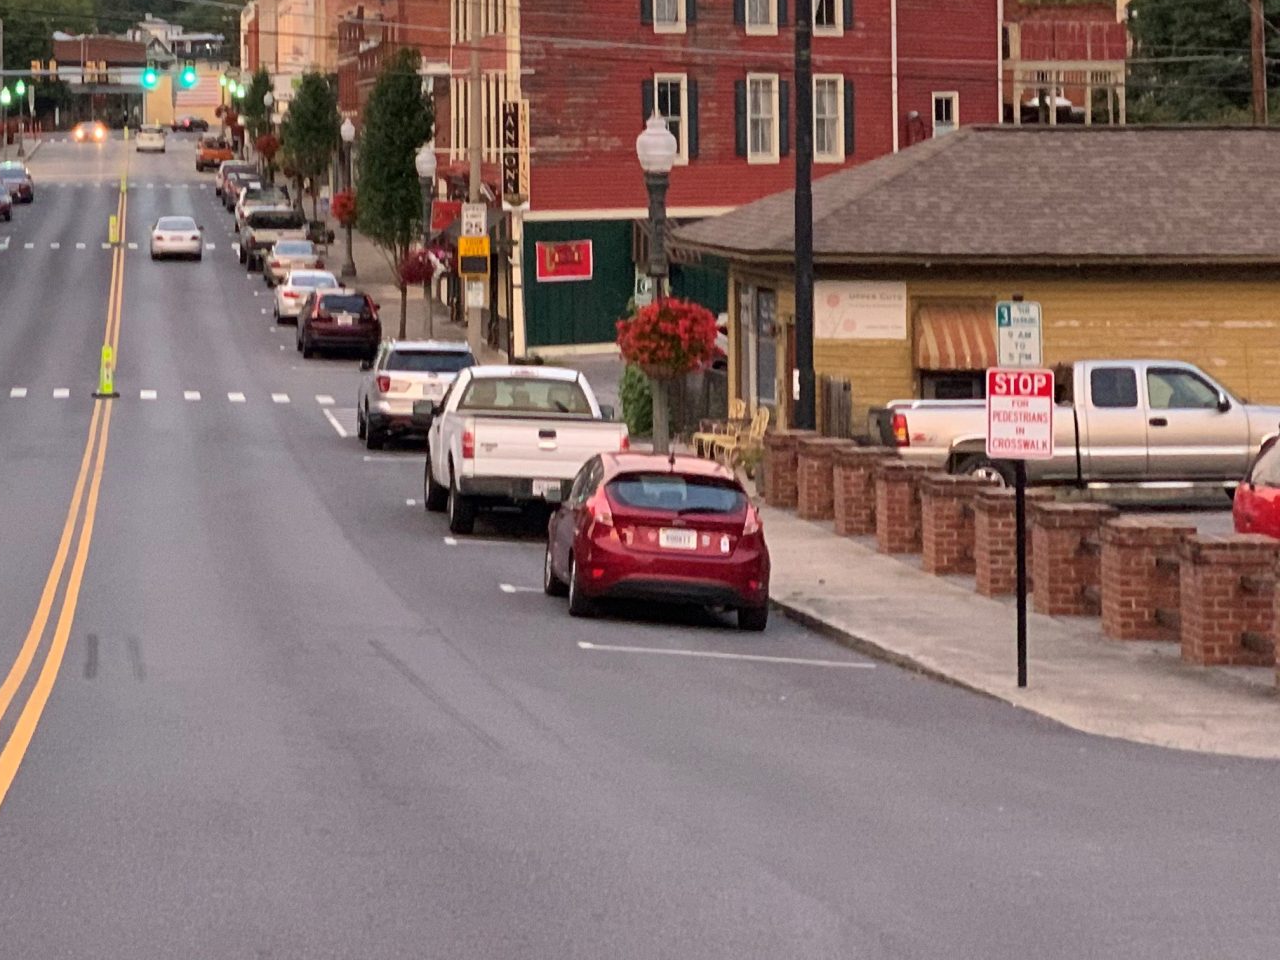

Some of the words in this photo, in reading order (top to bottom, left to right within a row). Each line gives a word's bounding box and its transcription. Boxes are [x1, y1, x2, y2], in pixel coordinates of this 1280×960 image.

[465, 222, 483, 235] 25
[1000, 306, 1009, 325] 3
[1018, 331, 1031, 339] AM
[1014, 341, 1026, 350] TO
[995, 373, 1047, 395] STOP
[1011, 400, 1029, 408] FOR
[992, 410, 1048, 423] PEDESTRIANS
[1015, 426, 1025, 435] IN
[992, 438, 1048, 451] CROSSWALK
